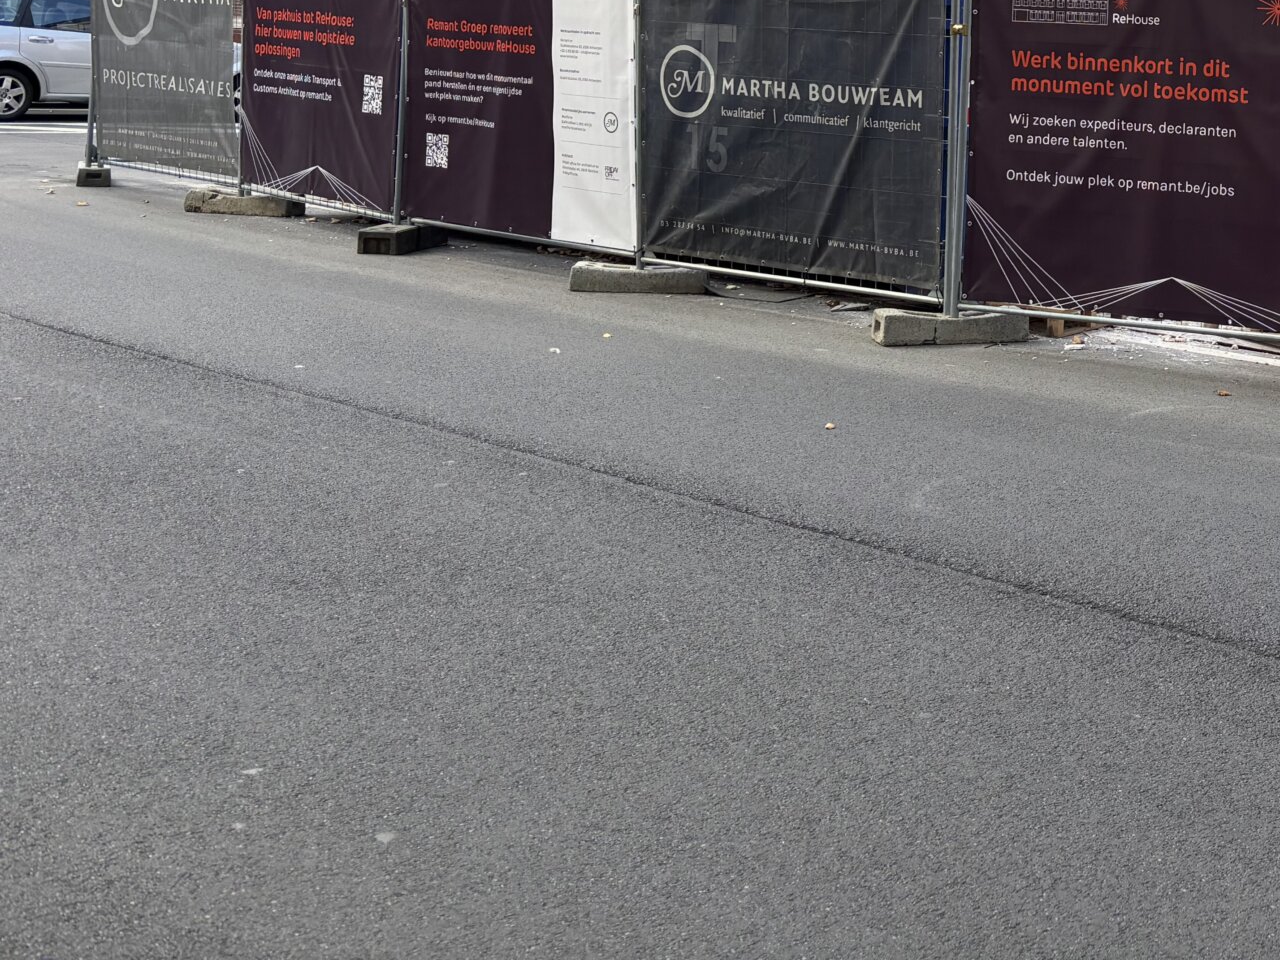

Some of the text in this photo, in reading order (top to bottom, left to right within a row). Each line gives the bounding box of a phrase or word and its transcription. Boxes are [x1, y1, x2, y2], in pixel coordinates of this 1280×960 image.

[257, 7, 355, 26] Van pakhuis tot ReHouse:
[1112, 12, 1160, 26] ReHouse
[255, 24, 355, 46] hier bouwen we logistieke
[428, 18, 533, 36] Remant Groep renoveert
[255, 43, 301, 59] oplossingen
[427, 35, 536, 54] kantoorgebouw ReHouse
[1012, 50, 1230, 78] Werk binnenkort in dit
[254, 68, 336, 87] Ontdek onze aanpak als Transport
[425, 68, 453, 78] Benieuwd
[453, 71, 465, 79] naar
[466, 71, 477, 80] hoe
[494, 75, 534, 85] monumentaal
[253, 84, 332, 102] Customs Architect op remant.be
[425, 80, 442, 89] pand
[443, 81, 468, 91] herstellen
[476, 84, 482, 92] er
[493, 85, 522, 97] eigentijdse
[425, 91, 452, 101] werkplek
[462, 94, 484, 103] maken?
[722, 77, 800, 100] MARTHA
[809, 83, 923, 109] BOUWTEAM
[1011, 76, 1249, 104] monument vol toekomst
[426, 113, 495, 128] Kijk op remant.be/ReHouse
[721, 106, 921, 132] kwalitatief communicatief klantgericht
[1009, 113, 1237, 138] Wij zoeken expediteurs, declaranten
[1008, 133, 1128, 150] en andere talenten.
[1006, 169, 1235, 198] Ontdek jouw plek op remant.be/jobs
[661, 220, 670, 228] 03
[721, 227, 812, 245] INFO@MARTHA-BVBA.BE
[828, 239, 920, 257] WWW.MARTHA-BVBA.BE
